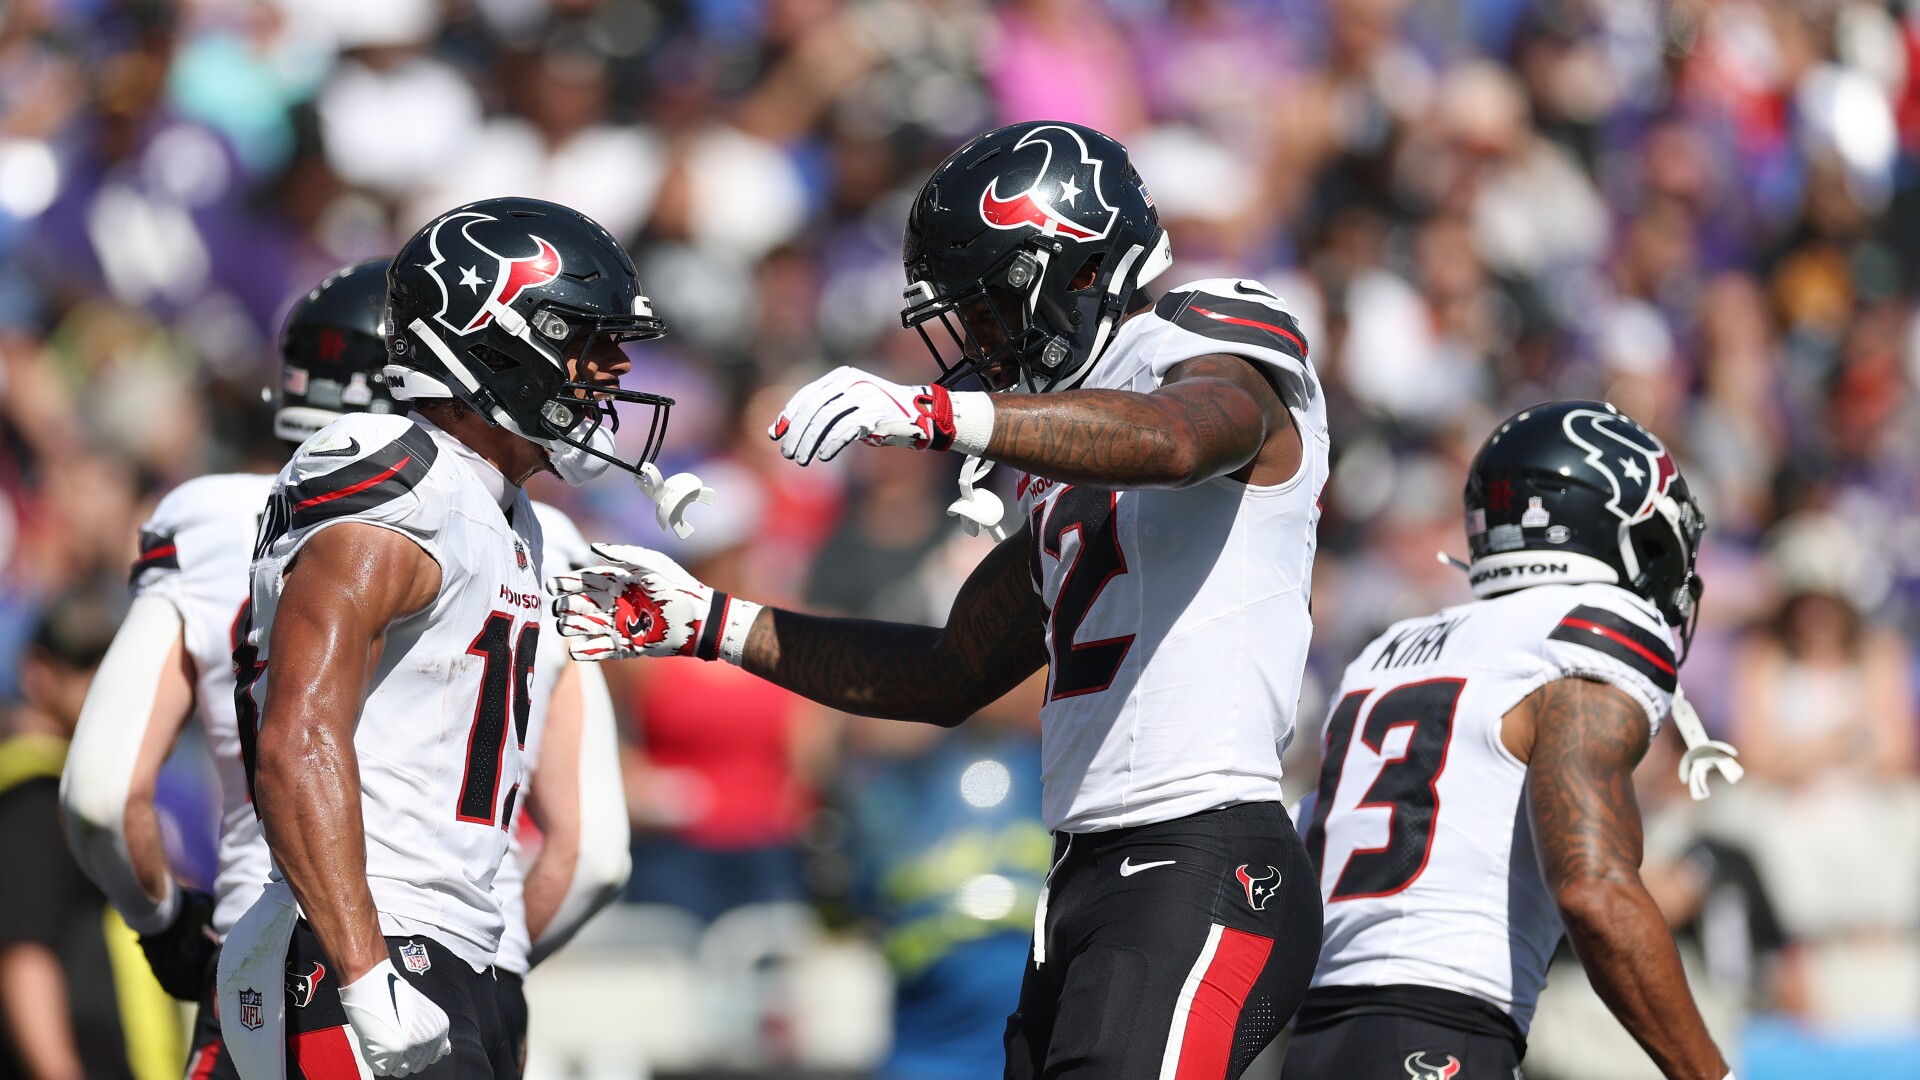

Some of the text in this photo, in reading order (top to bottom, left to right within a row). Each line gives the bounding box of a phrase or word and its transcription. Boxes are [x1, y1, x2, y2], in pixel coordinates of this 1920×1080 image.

[1371, 612, 1472, 671] KIRK
[1306, 677, 1467, 903] 13
[408, 955, 429, 969] NFL
[242, 1005, 262, 1026] NFL
